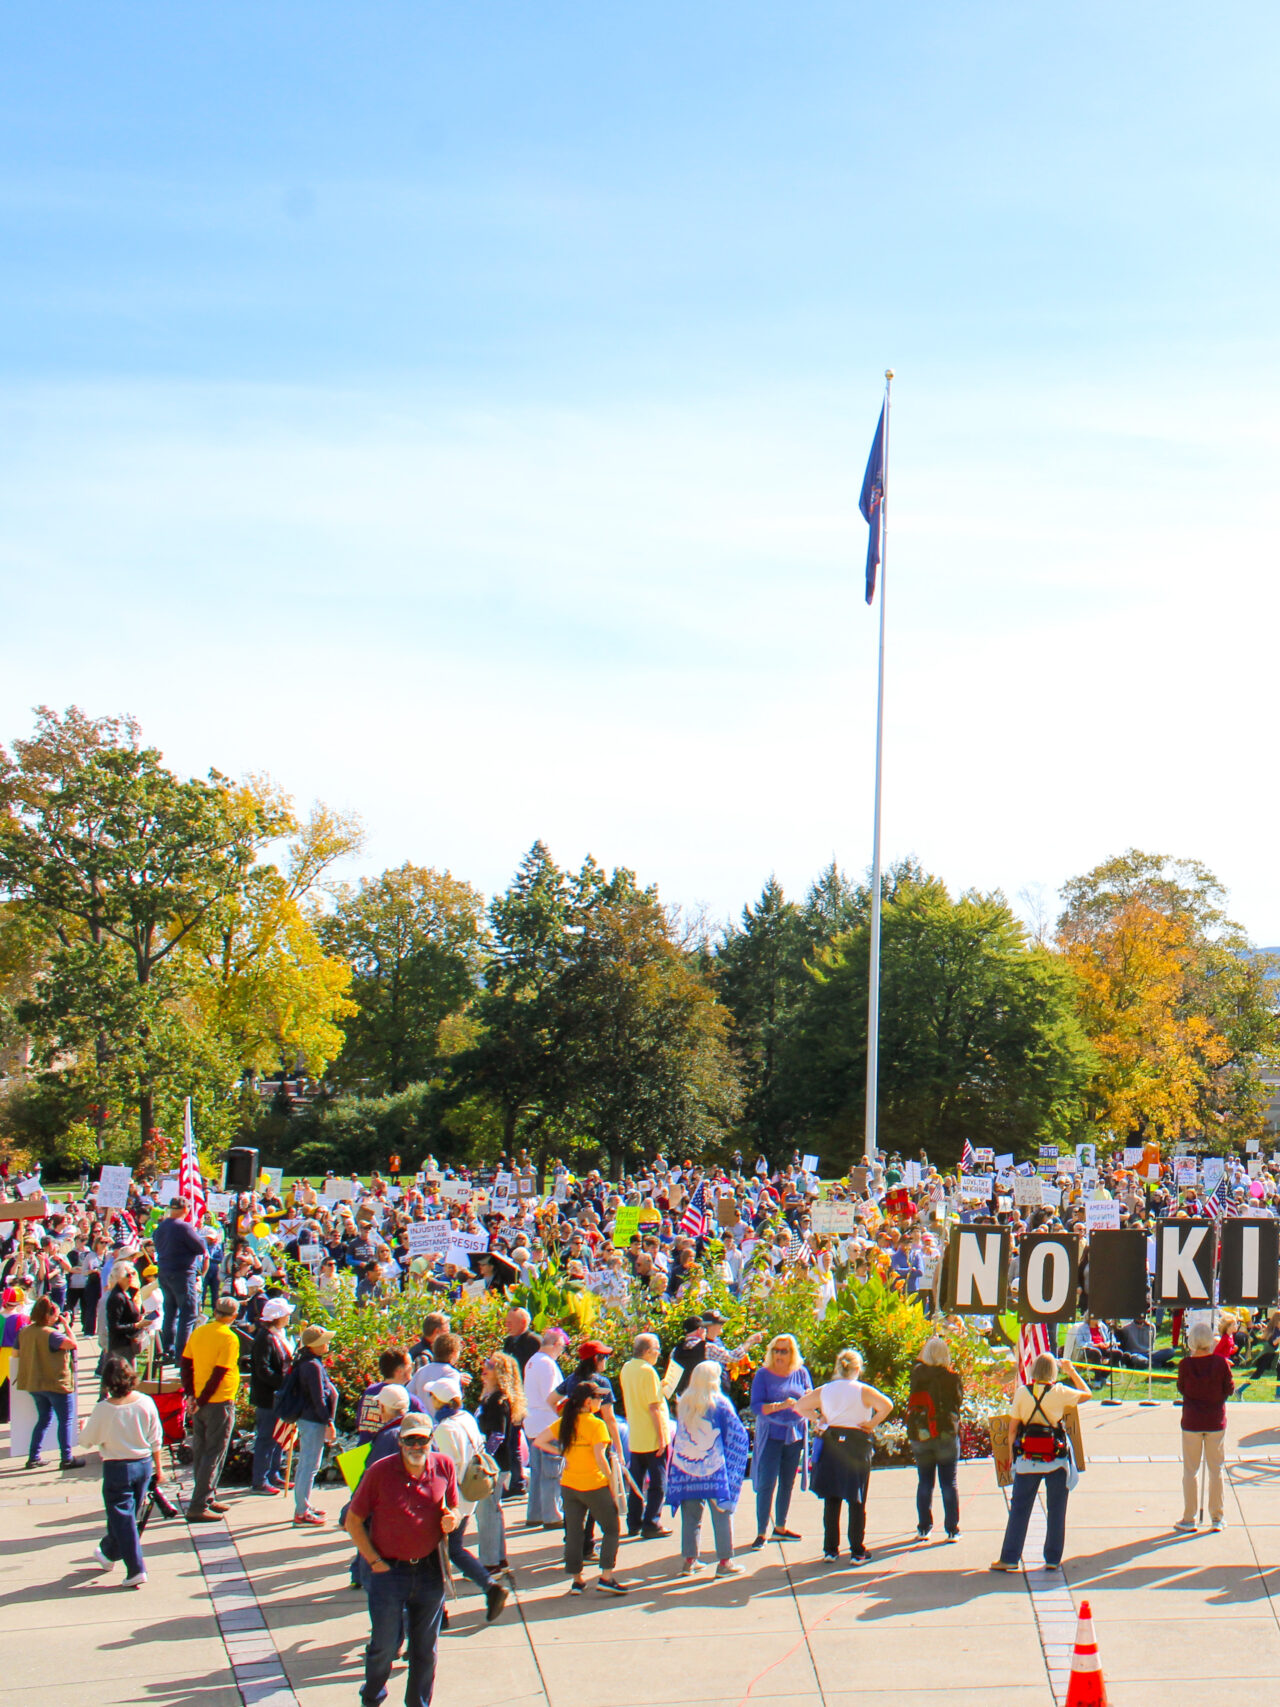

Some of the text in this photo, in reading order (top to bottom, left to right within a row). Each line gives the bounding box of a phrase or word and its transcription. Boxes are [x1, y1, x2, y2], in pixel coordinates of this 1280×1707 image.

[410, 1224, 447, 1235] INJUSTICE
[409, 1237, 452, 1248] RESISTANCE
[452, 1236, 486, 1251] RESIST
[956, 1232, 1070, 1314] NO
